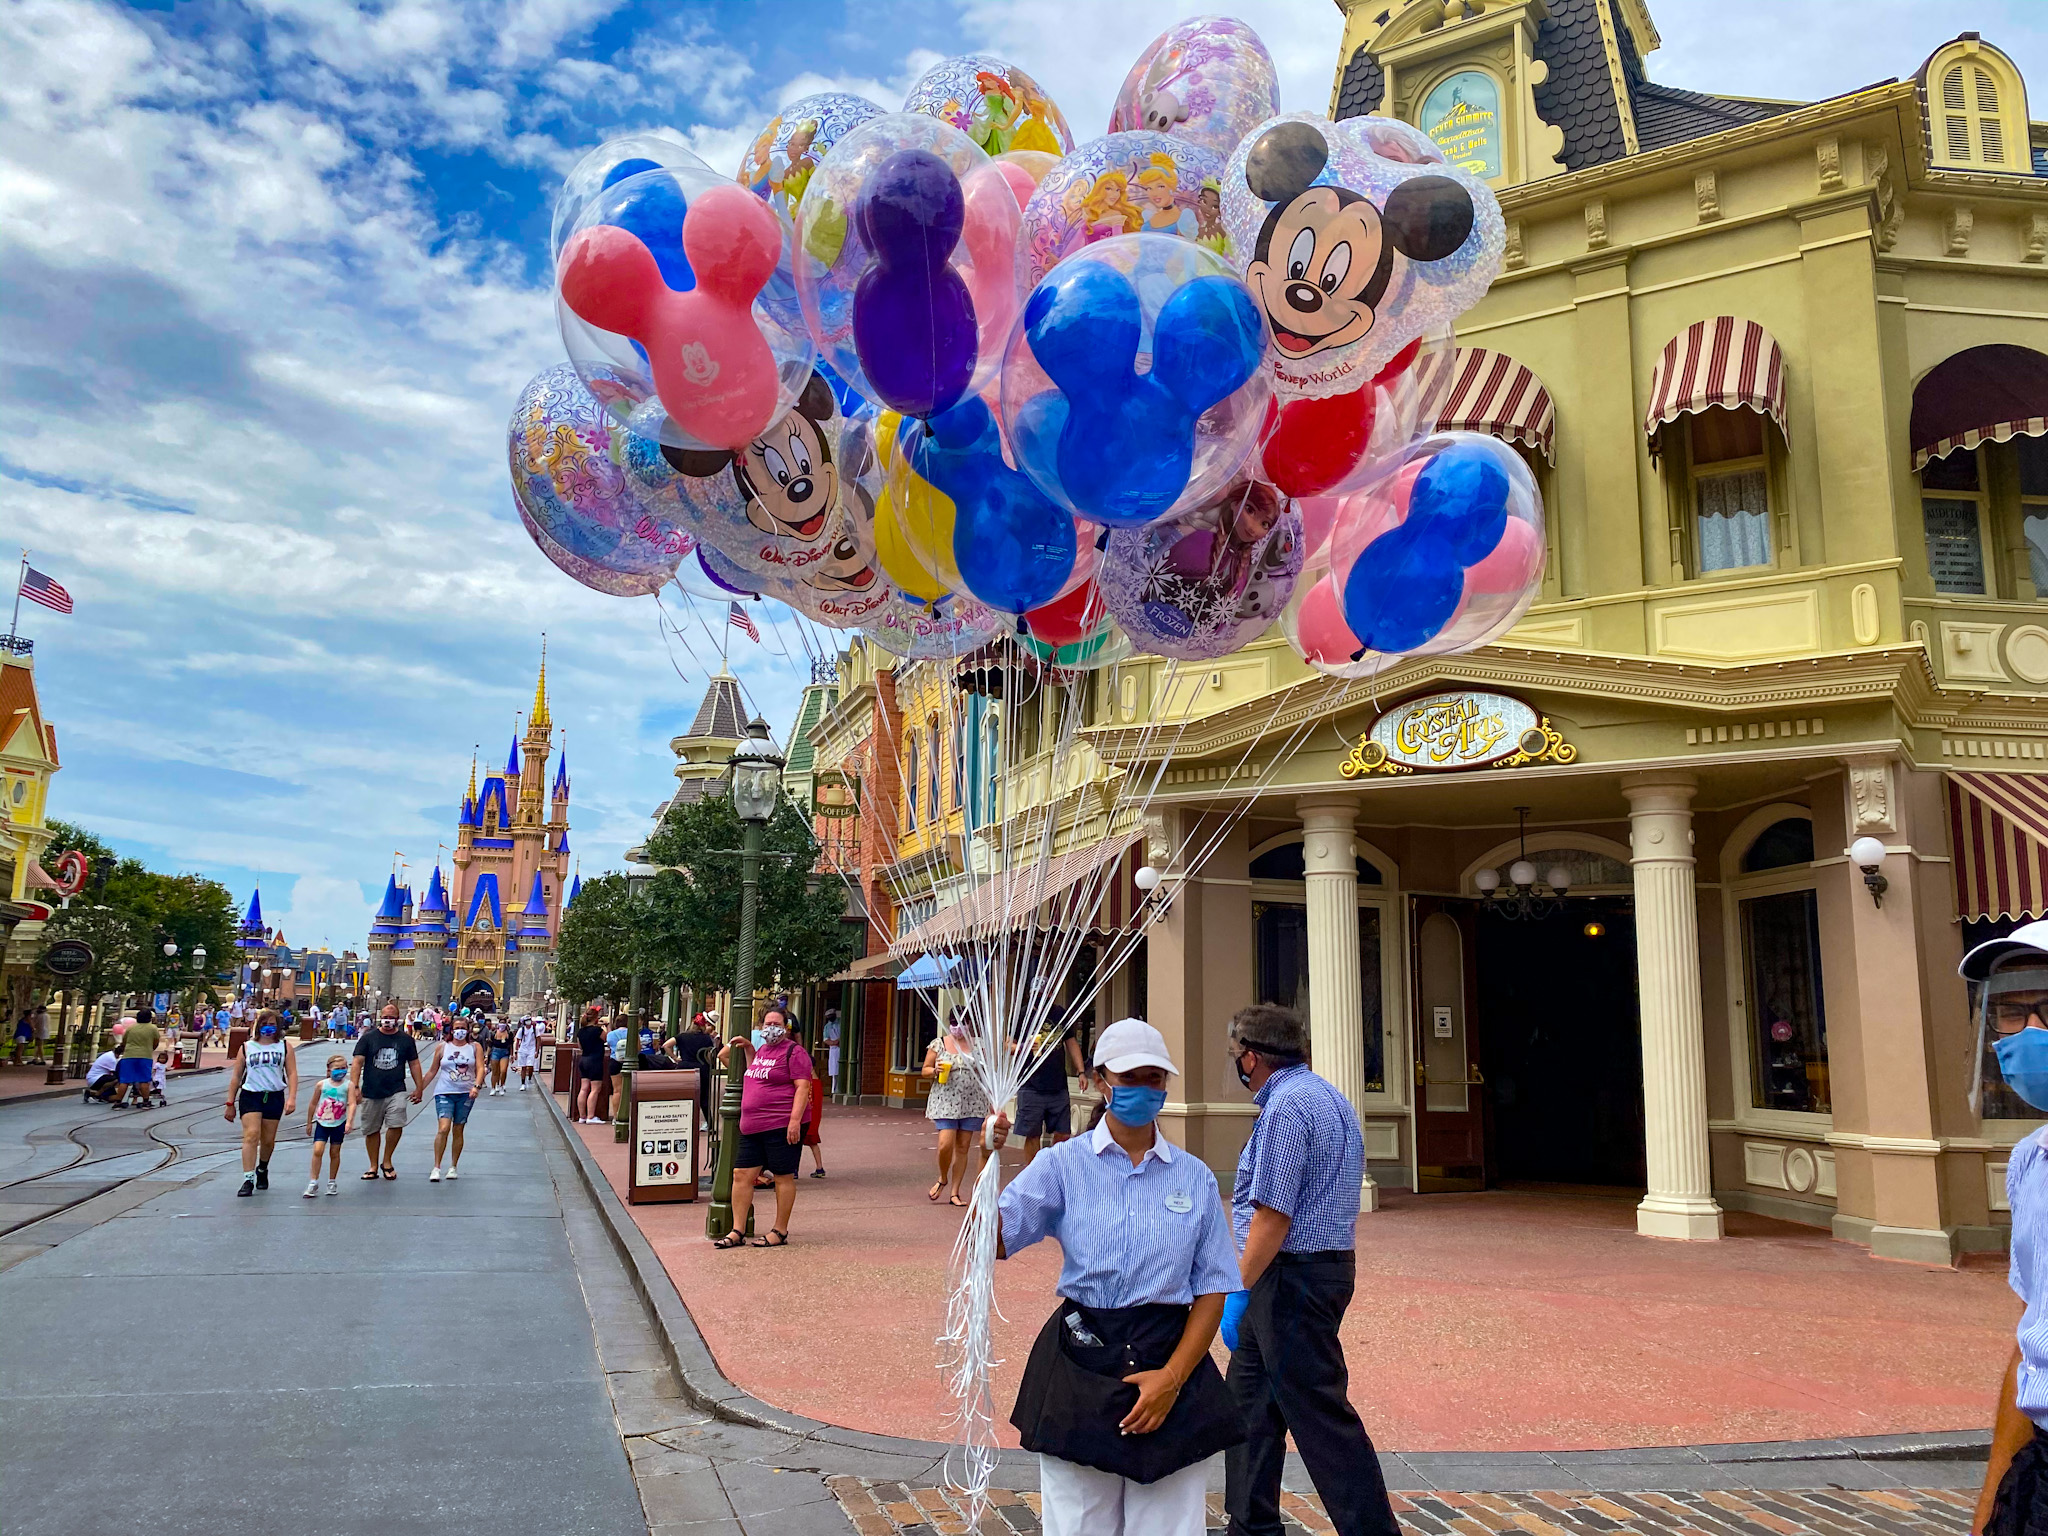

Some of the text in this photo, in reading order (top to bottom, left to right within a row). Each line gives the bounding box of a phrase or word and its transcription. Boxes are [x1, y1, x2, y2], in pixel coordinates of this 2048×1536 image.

[1442, 144, 1458, 156] rank
[1468, 137, 1487, 149] Wells
[1309, 362, 1353, 385] World
[1149, 605, 1190, 635] FROZEN
[821, 805, 851, 816] COFFEE
[249, 1051, 282, 1068] WDW
